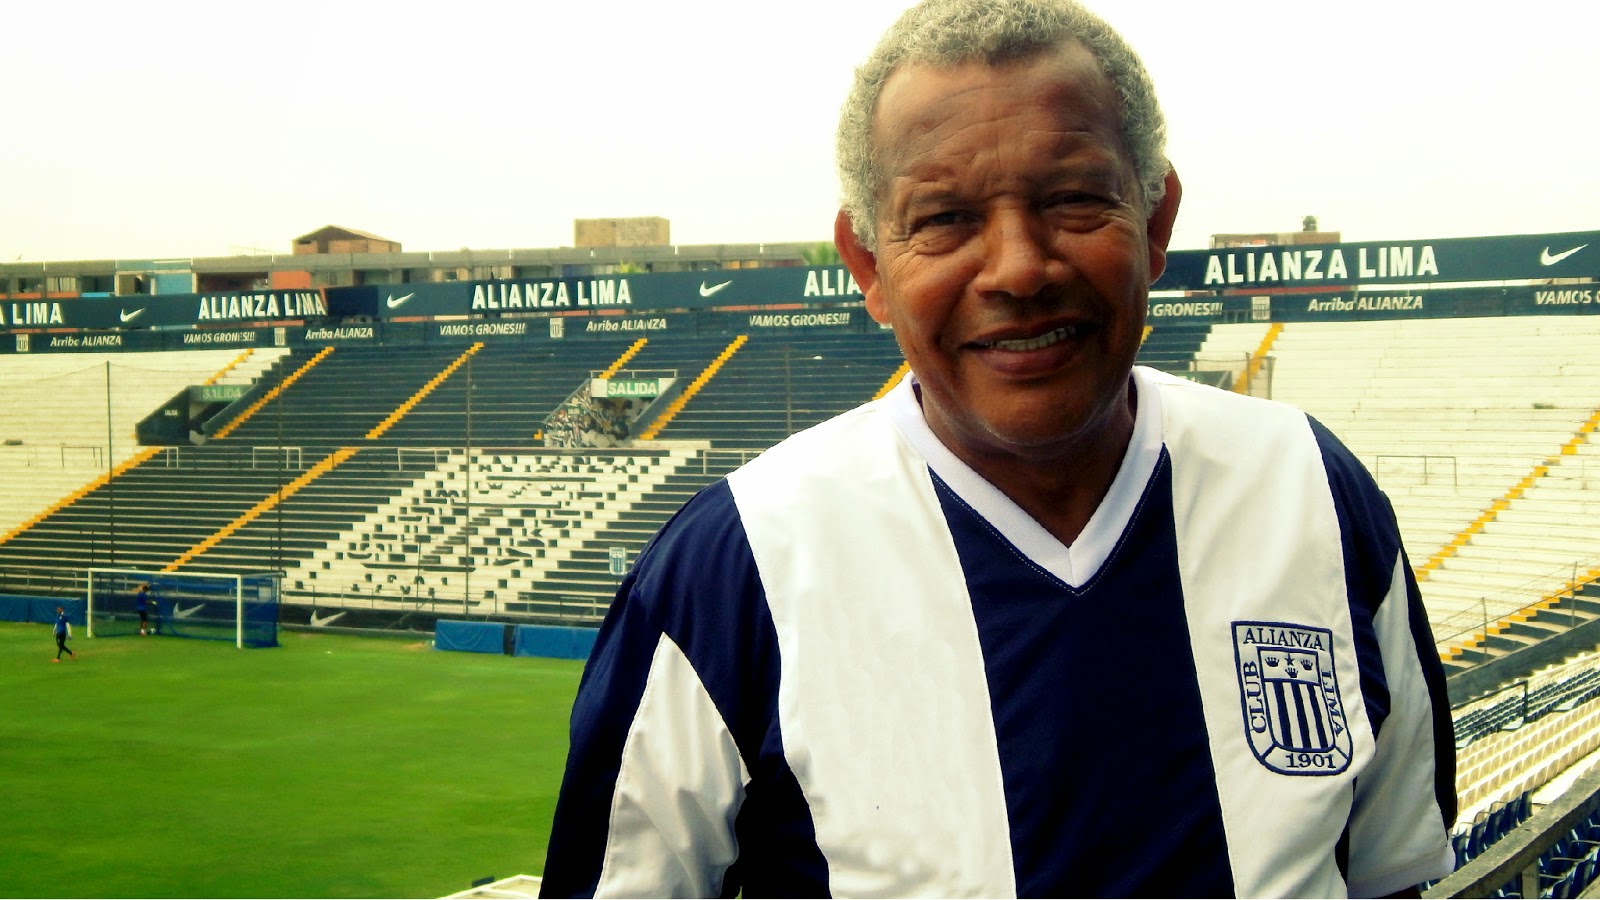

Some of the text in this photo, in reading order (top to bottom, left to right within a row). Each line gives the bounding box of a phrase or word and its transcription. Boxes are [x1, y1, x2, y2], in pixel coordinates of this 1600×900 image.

[1204, 245, 1439, 285] ALIANZA LIMA
[803, 269, 863, 297] ALIA
[472, 279, 632, 310] ALIANZA LIMA
[1536, 290, 1592, 304] VAMOS
[198, 292, 326, 319] ALIANZA LIMA
[1152, 303, 1223, 317] GRONES!!!
[1307, 295, 1423, 312] Arriba ALIANZA
[12, 302, 63, 325] LIMA
[749, 312, 850, 328] VAMOS GRONES!!!
[439, 322, 525, 336] VAMOS GRONES!!!
[586, 318, 667, 332] Arriba ALIANZA
[81, 335, 122, 346] ALIANZA
[183, 333, 212, 344] VAMOS
[305, 327, 373, 340] Arriba ALIANZA
[202, 388, 241, 398] SALIDA
[607, 381, 657, 395] SALIDA
[1243, 628, 1325, 651] ALIANZA
[1243, 660, 1266, 734] CLUB
[1321, 670, 1345, 737] LIMA
[1285, 753, 1337, 769] 1901
